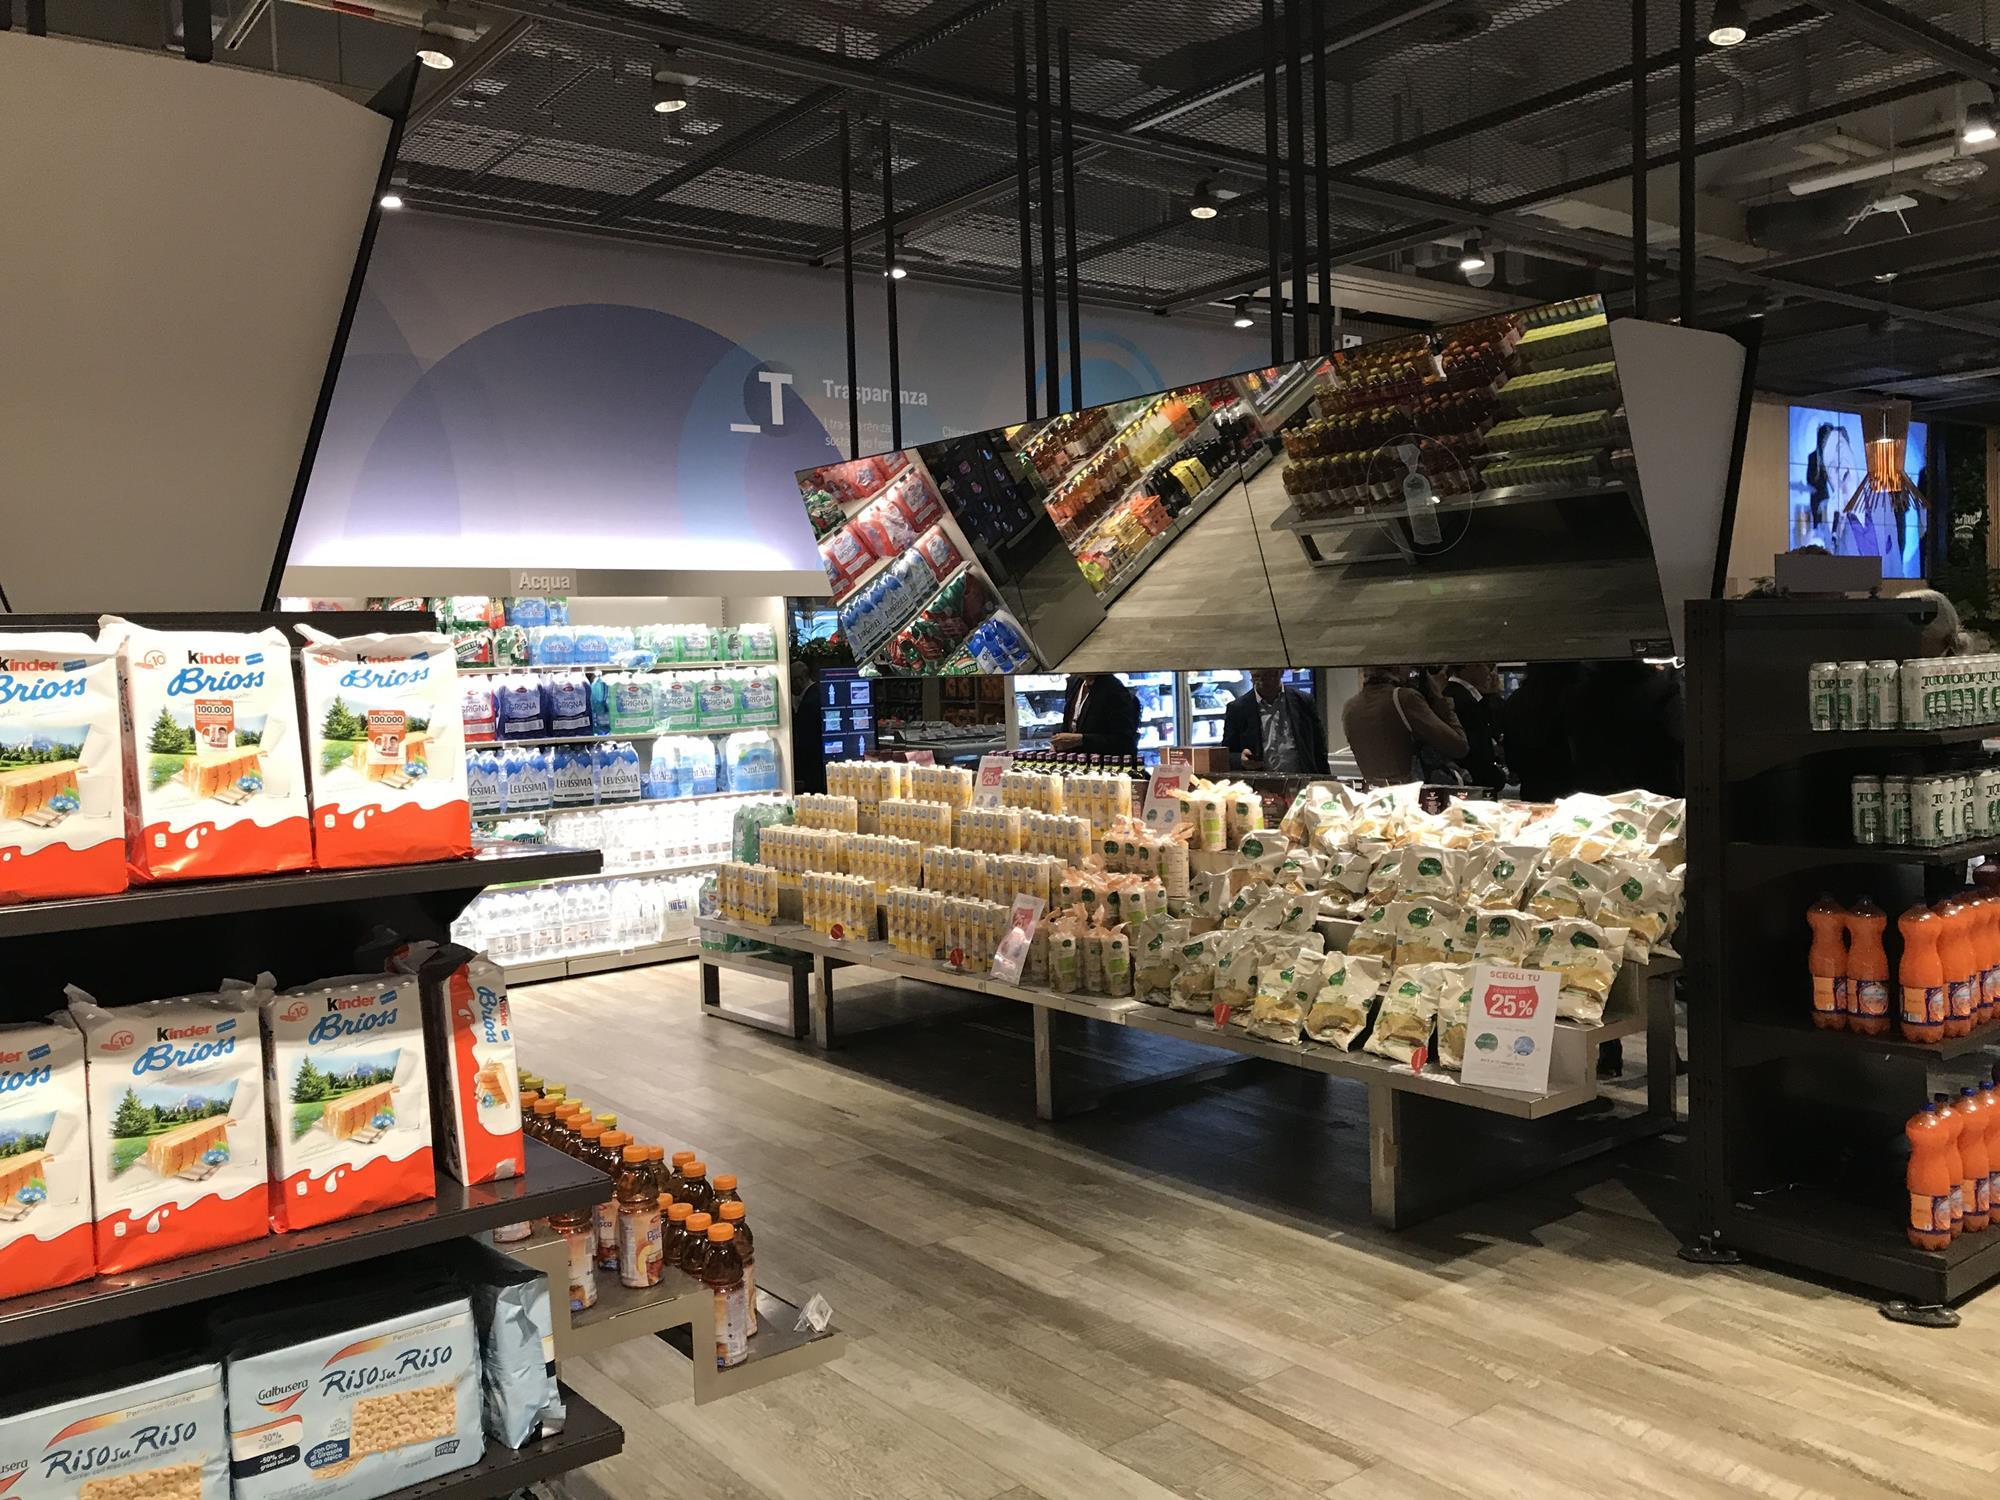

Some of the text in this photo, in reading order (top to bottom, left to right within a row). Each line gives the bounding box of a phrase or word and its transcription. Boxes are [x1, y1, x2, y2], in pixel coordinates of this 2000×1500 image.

[823, 380, 928, 406] Traparnza
[519, 573, 570, 593] Acqua
[167, 667, 265, 697] Brioss
[340, 667, 430, 688] Brioss
[0, 675, 87, 704] Brioss
[197, 705, 231, 714] 100.000
[370, 715, 403, 724] 100.000
[510, 782, 548, 794] LEVISSIMA
[556, 777, 592, 788] LEVISSIMA
[603, 773, 639, 785] LEVISSIMA
[470, 785, 497, 796] ISSIMA
[1490, 970, 1541, 982] SCEGLI TU
[476, 986, 498, 1043] Brioss
[1489, 993, 1533, 1016] 25%
[308, 1008, 398, 1045] Brioss
[132, 1036, 236, 1076] Brioss
[0, 1064, 52, 1093] ioss
[258, 1379, 309, 1401] Galbusera
